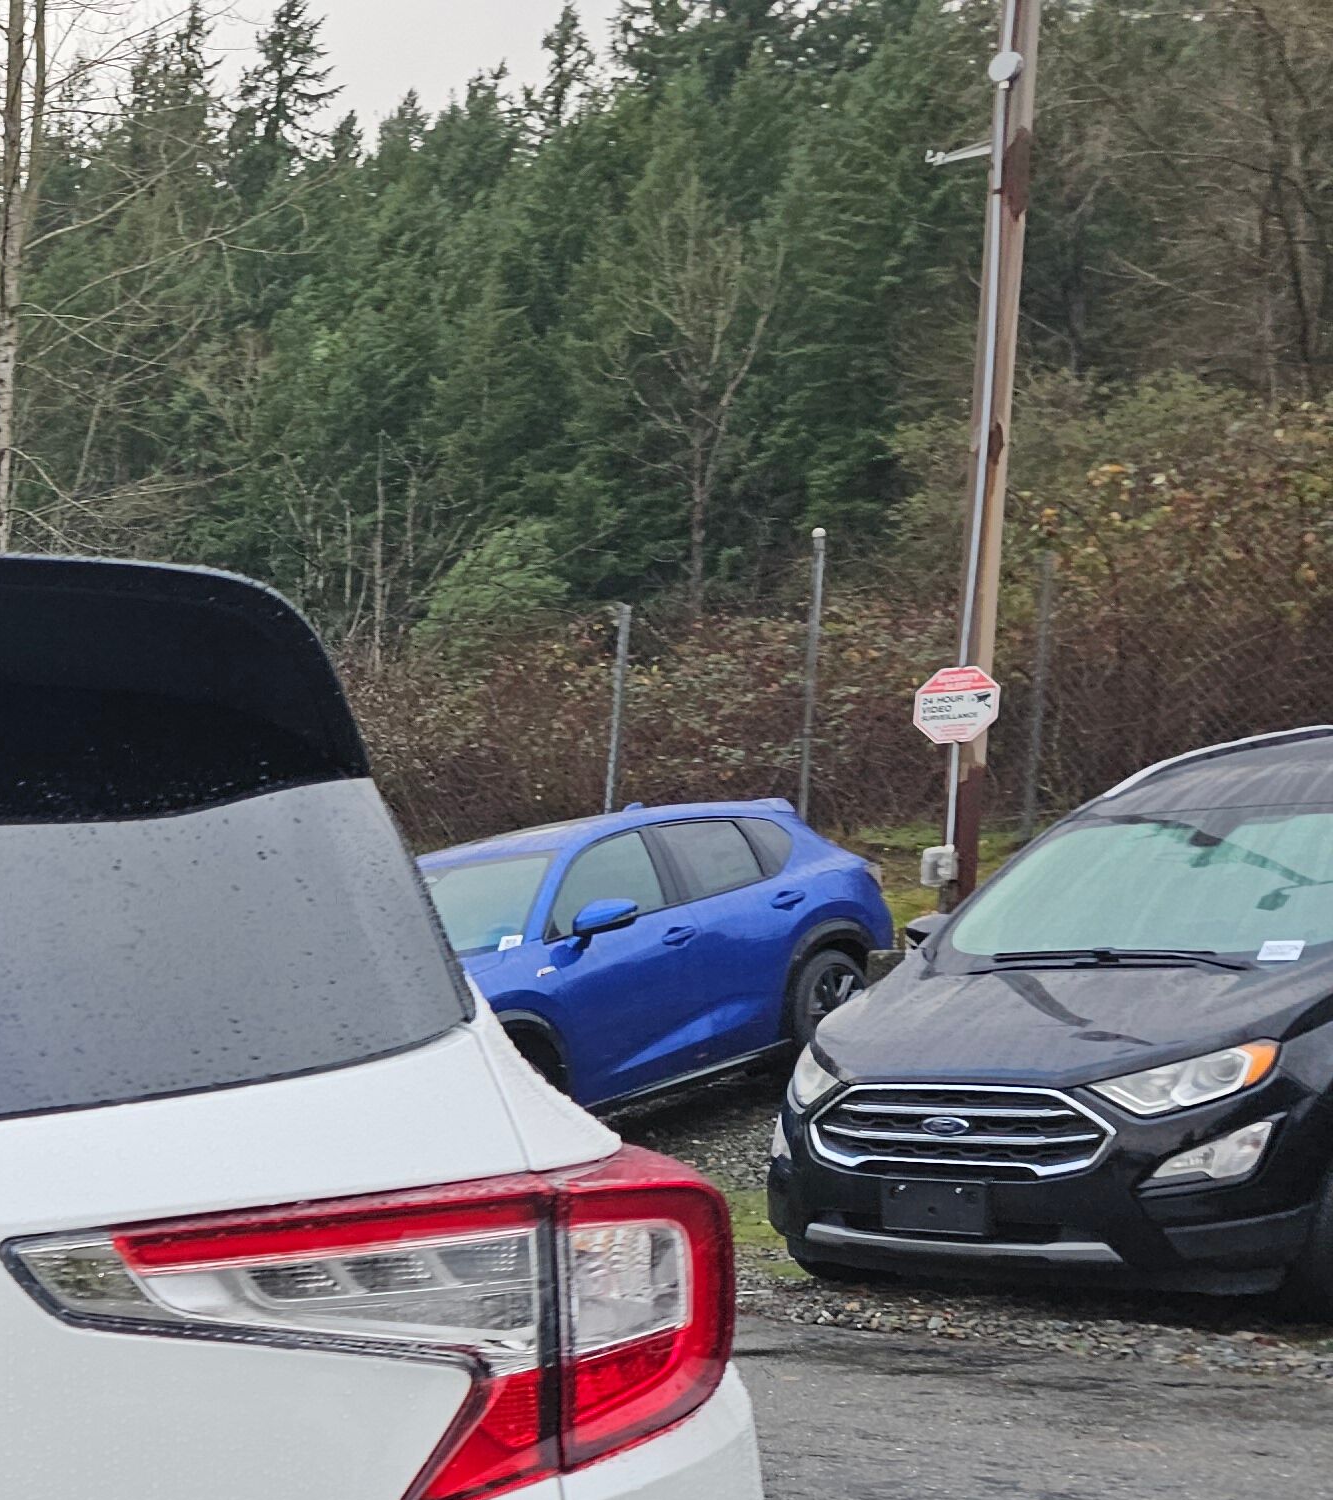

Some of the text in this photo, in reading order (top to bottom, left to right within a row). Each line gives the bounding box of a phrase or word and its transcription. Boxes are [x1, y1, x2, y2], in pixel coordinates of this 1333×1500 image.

[922, 694, 964, 705] 24 HOUR
[921, 705, 953, 714] VIDEO
[920, 711, 979, 721] SURVEILLANCE
